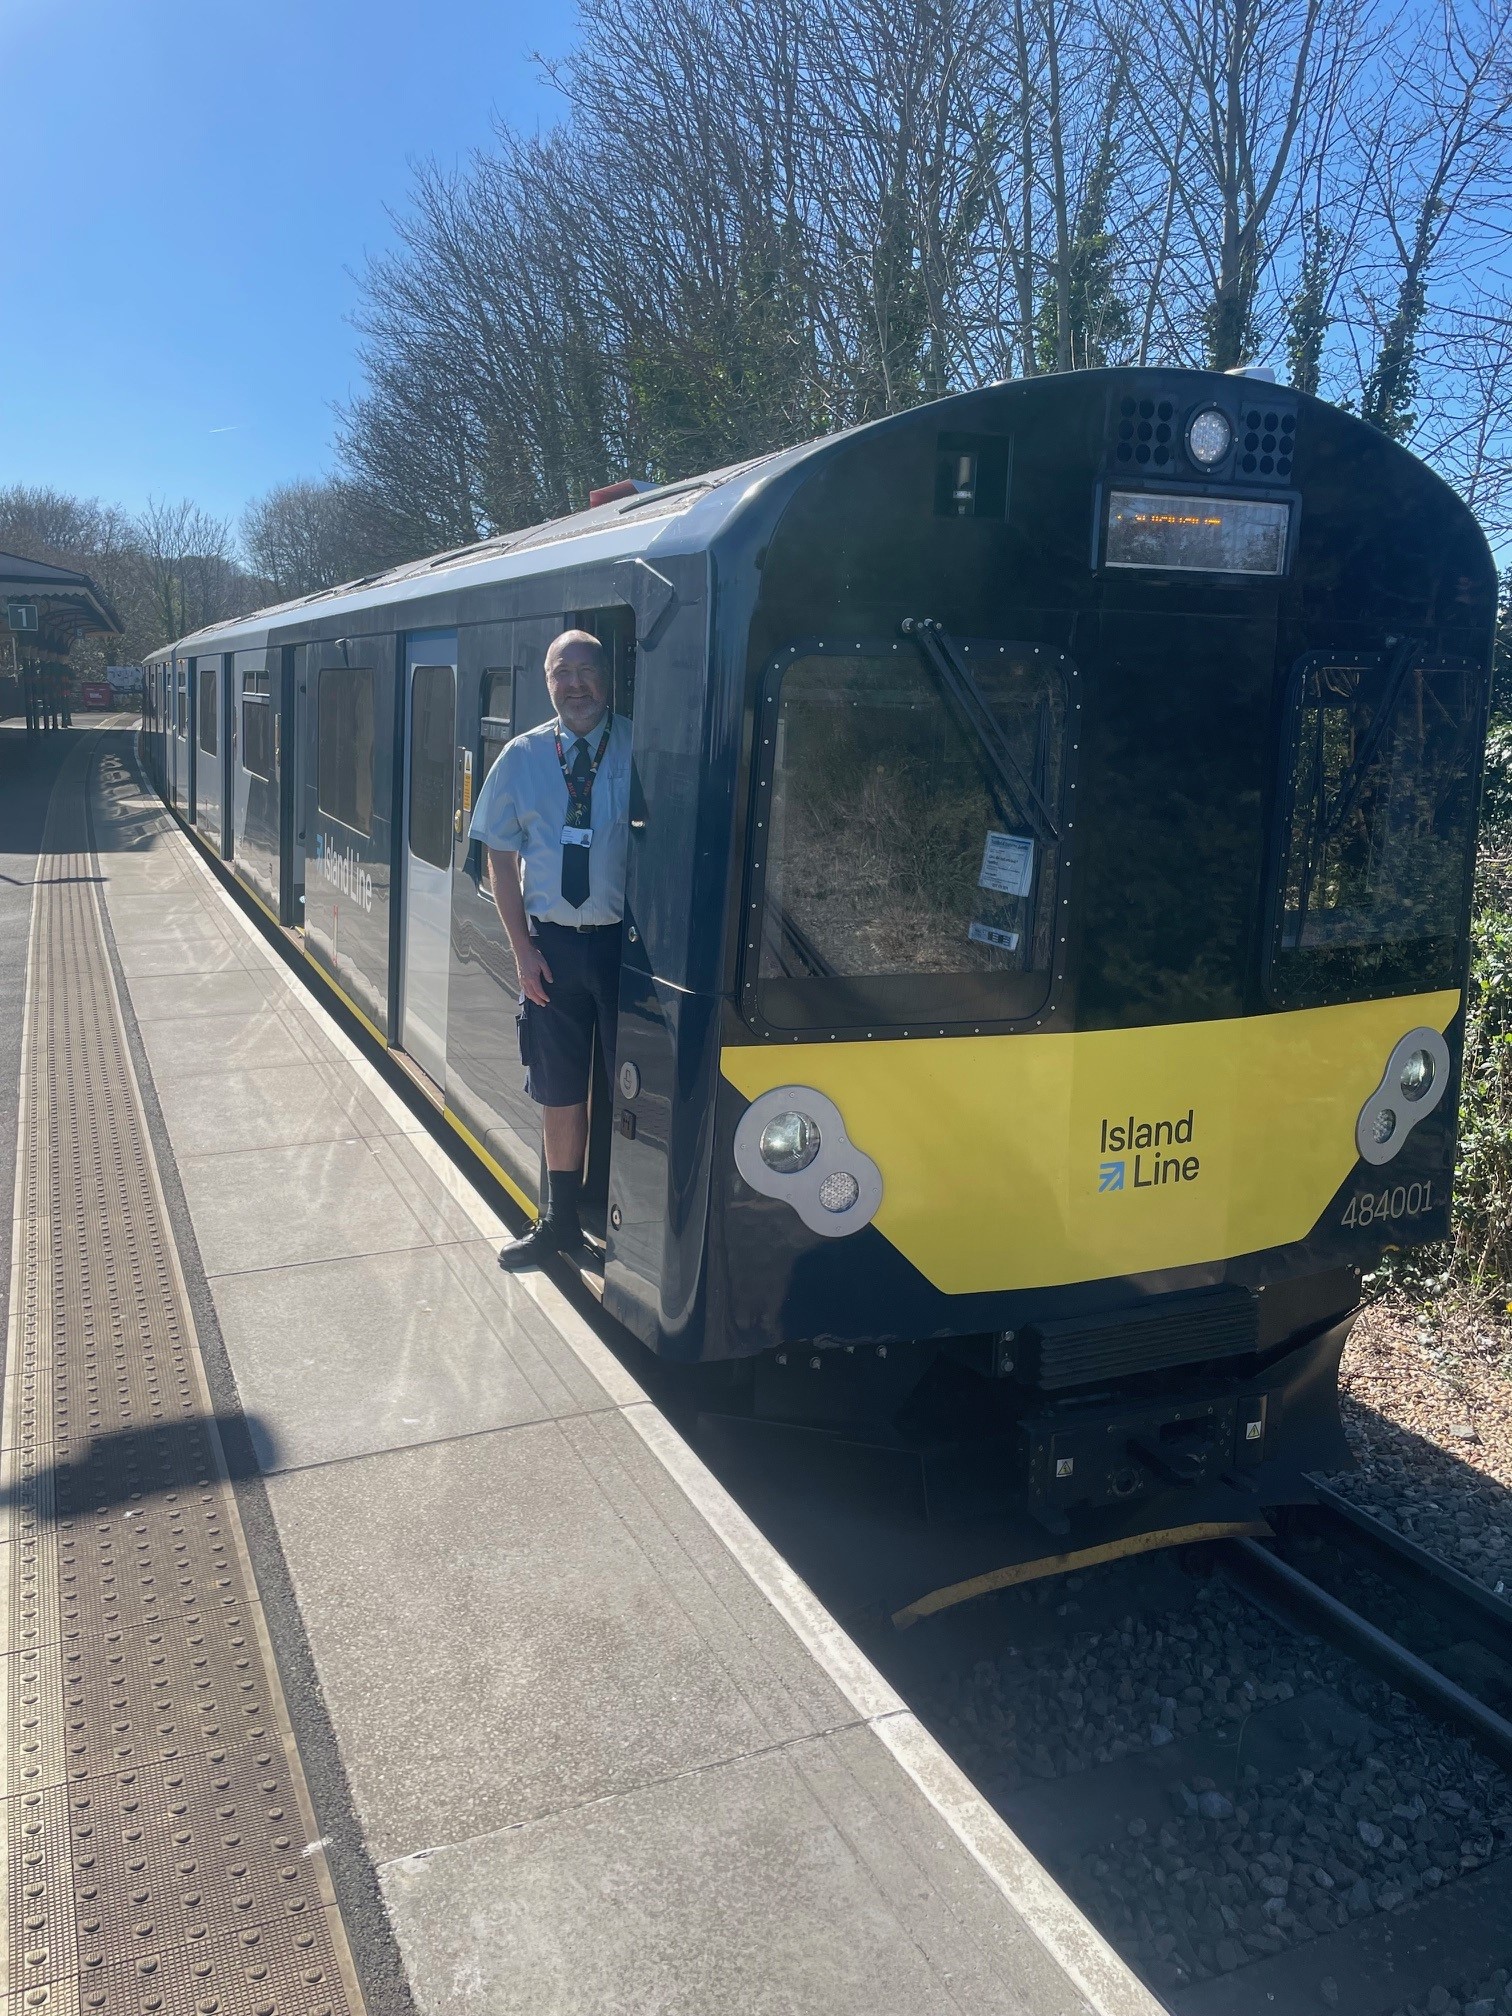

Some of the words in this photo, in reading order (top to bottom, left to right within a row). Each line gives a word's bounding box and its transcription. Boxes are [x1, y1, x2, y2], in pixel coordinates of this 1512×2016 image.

[17, 607, 28, 627] 1
[324, 832, 350, 896] Island
[350, 849, 372, 914] Line
[1100, 1109, 1194, 1153] Island
[1133, 1151, 1200, 1188] Line
[1340, 1180, 1433, 1230] 484001
